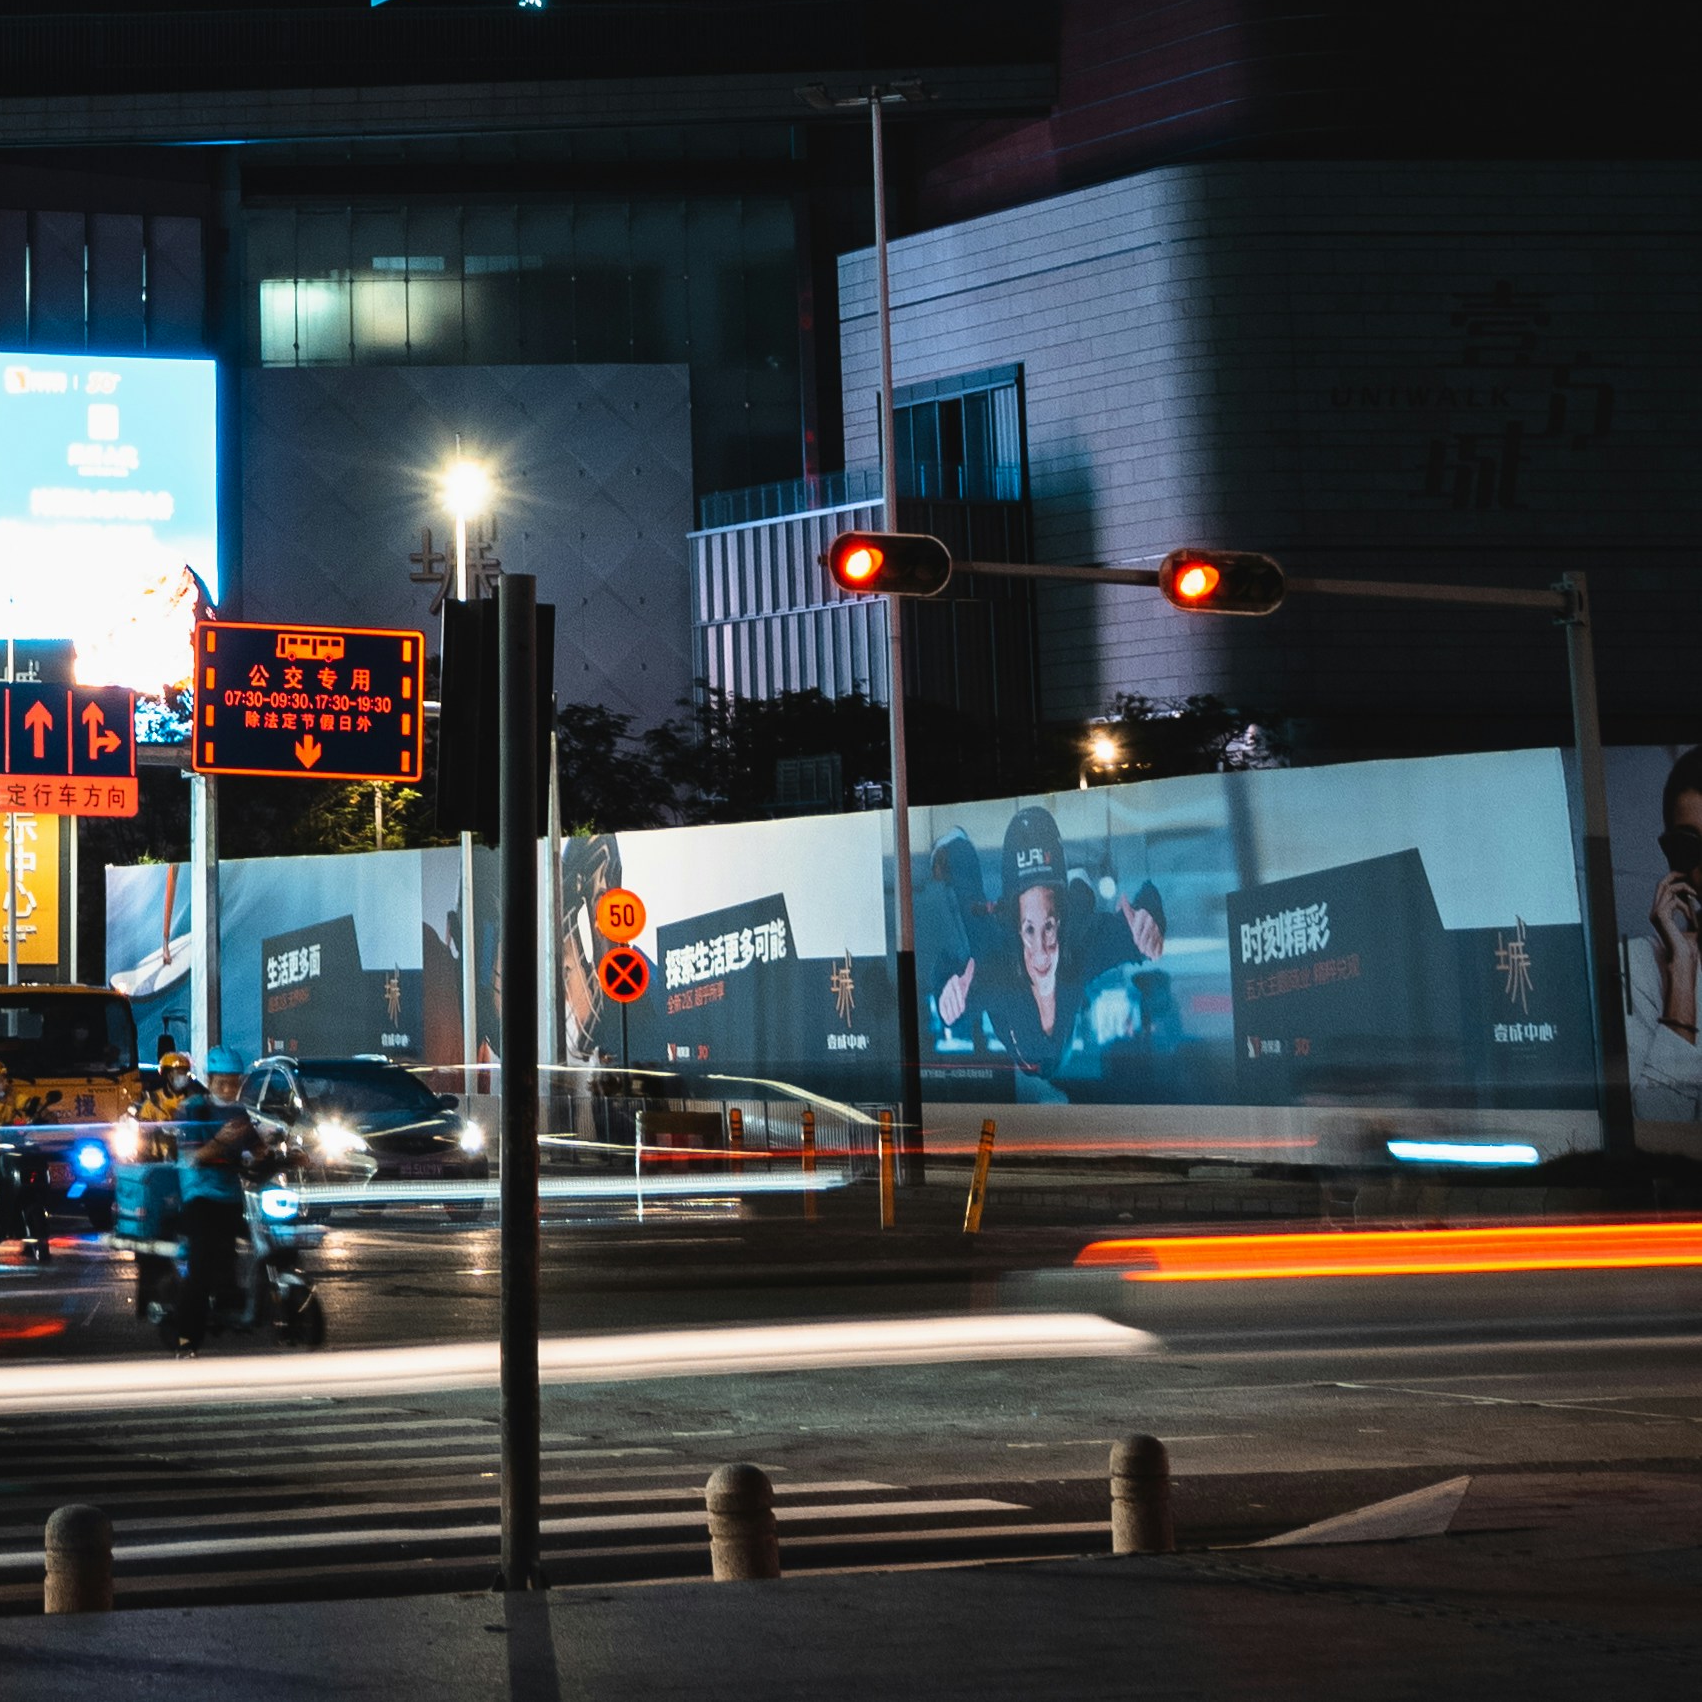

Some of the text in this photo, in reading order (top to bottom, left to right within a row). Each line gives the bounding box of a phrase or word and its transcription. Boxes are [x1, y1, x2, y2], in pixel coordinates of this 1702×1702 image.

[1329, 385, 1512, 409] UNIWALK
[249, 664, 371, 692] 公交专用
[244, 711, 372, 733] 除法定节假日外
[609, 903, 635, 928] 50
[1240, 900, 1331, 965] 时刻精彩
[267, 943, 321, 990] 生活更多面
[665, 916, 787, 990] 探索生活更多可能
